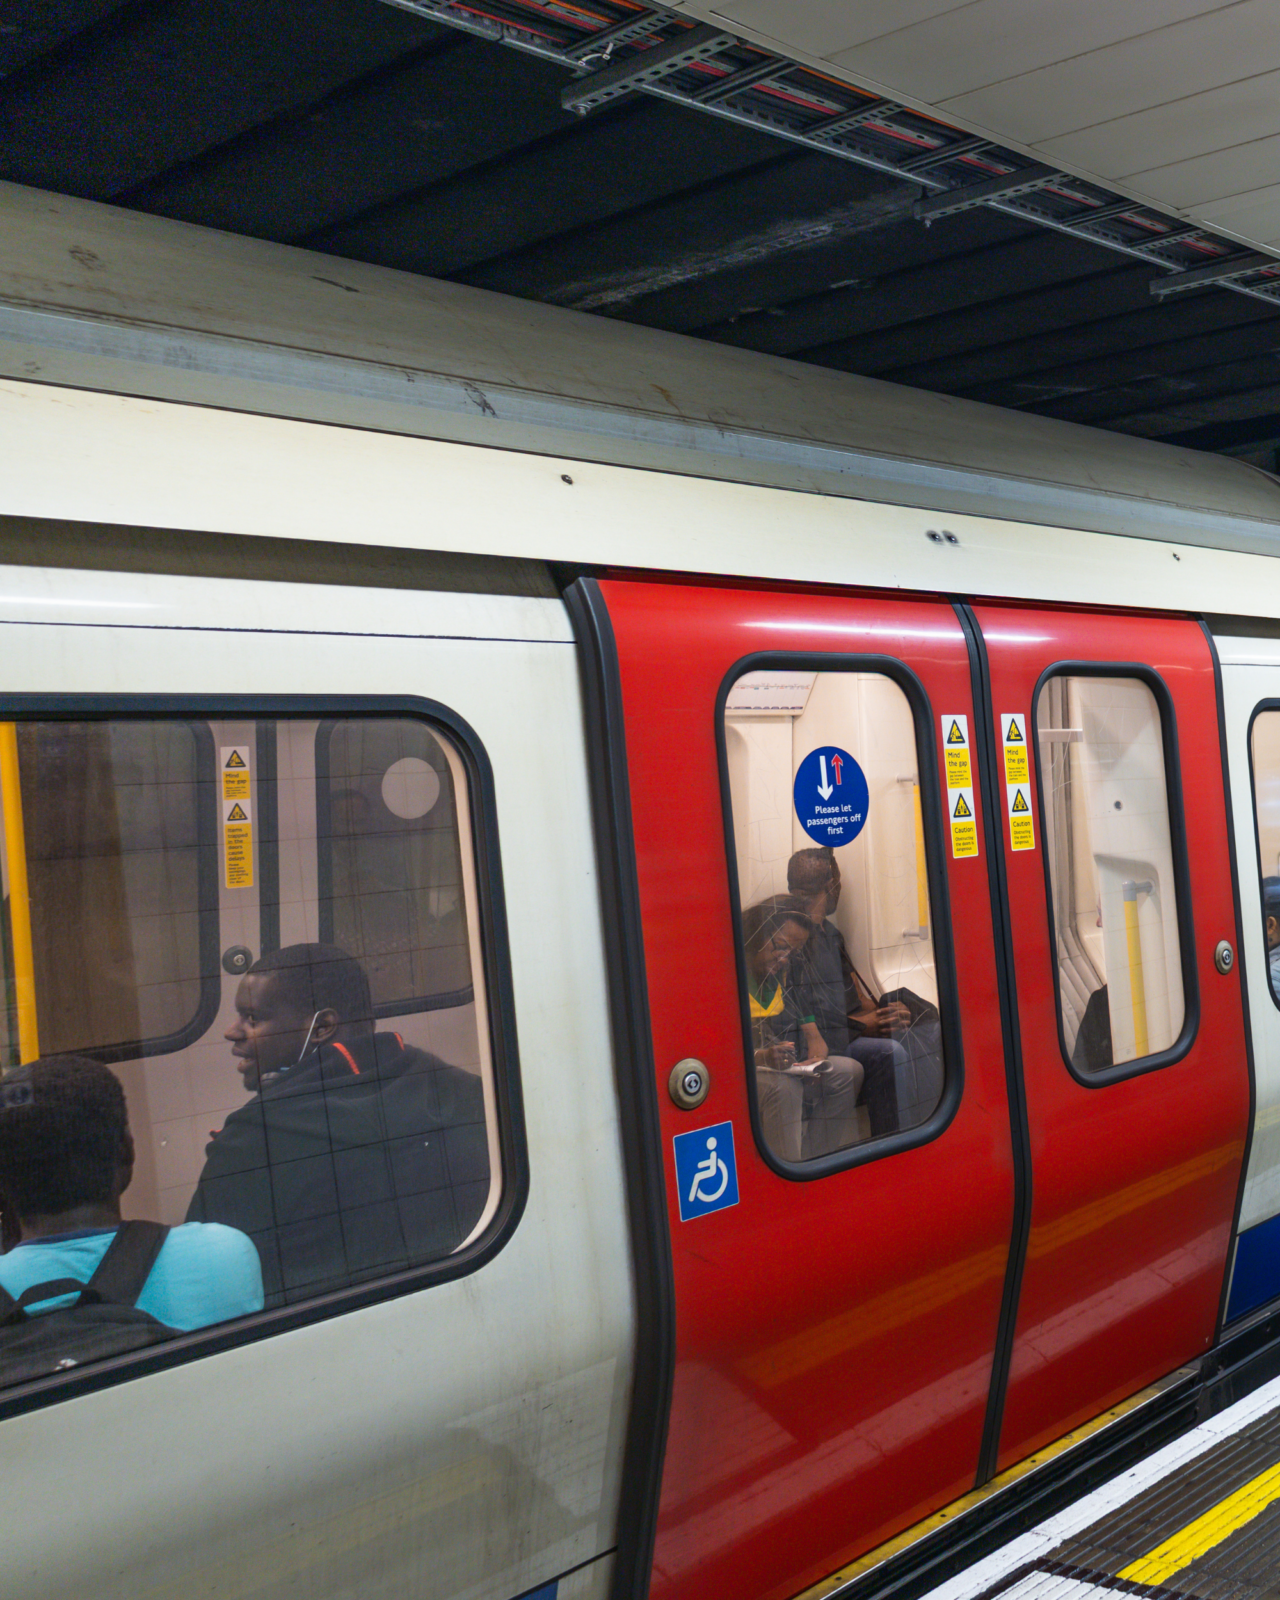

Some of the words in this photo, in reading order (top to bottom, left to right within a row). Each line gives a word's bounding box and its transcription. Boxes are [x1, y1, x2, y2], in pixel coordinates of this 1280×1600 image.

[959, 760, 968, 768] gap
[815, 806, 839, 814] Please
[841, 804, 852, 812] let
[807, 816, 849, 828] passengers
[850, 813, 861, 822] off
[827, 826, 844, 835] first
[955, 826, 973, 834] Caution
